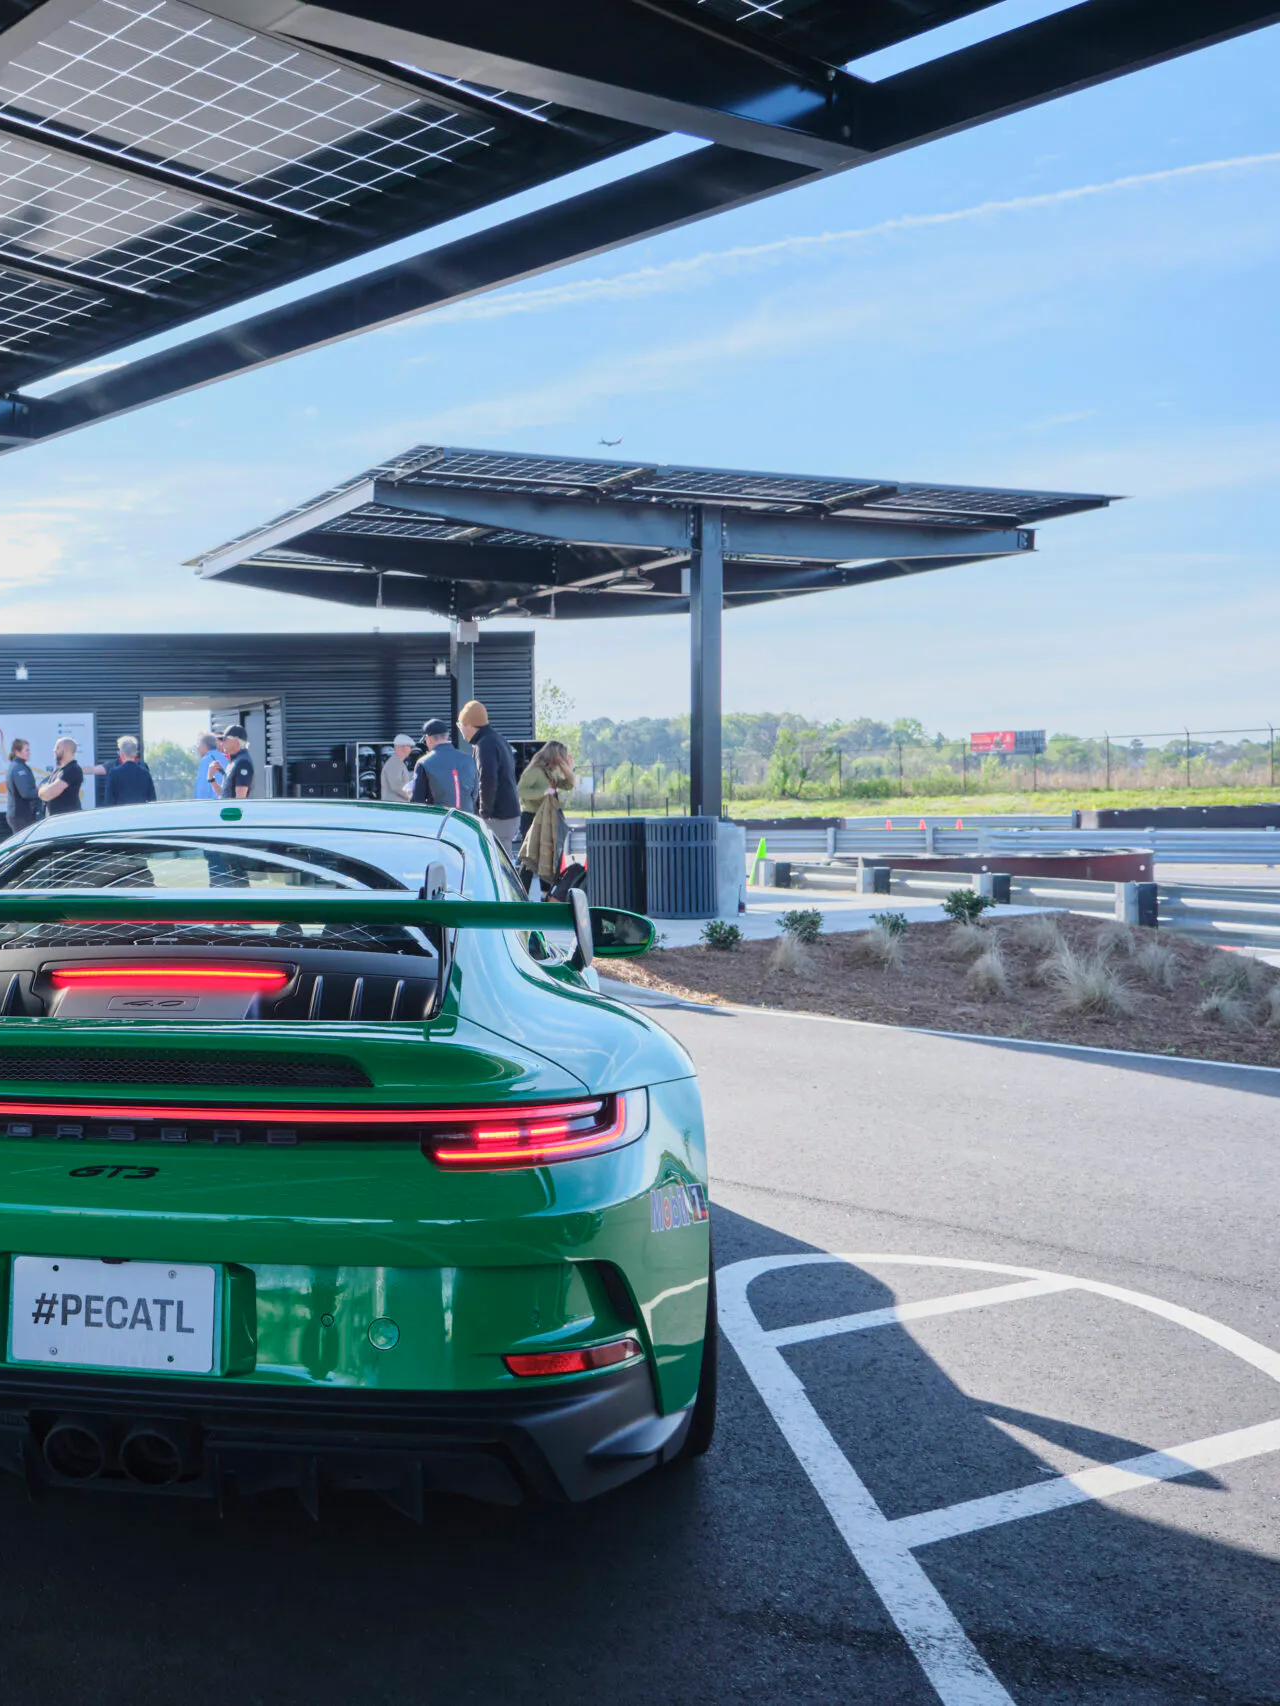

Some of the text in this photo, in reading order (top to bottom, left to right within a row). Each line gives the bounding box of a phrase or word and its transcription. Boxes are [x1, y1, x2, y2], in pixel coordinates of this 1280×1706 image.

[68, 1164, 160, 1180] GT3
[650, 1185, 690, 1233] Mobil
[32, 1292, 195, 1333] #PECATL
